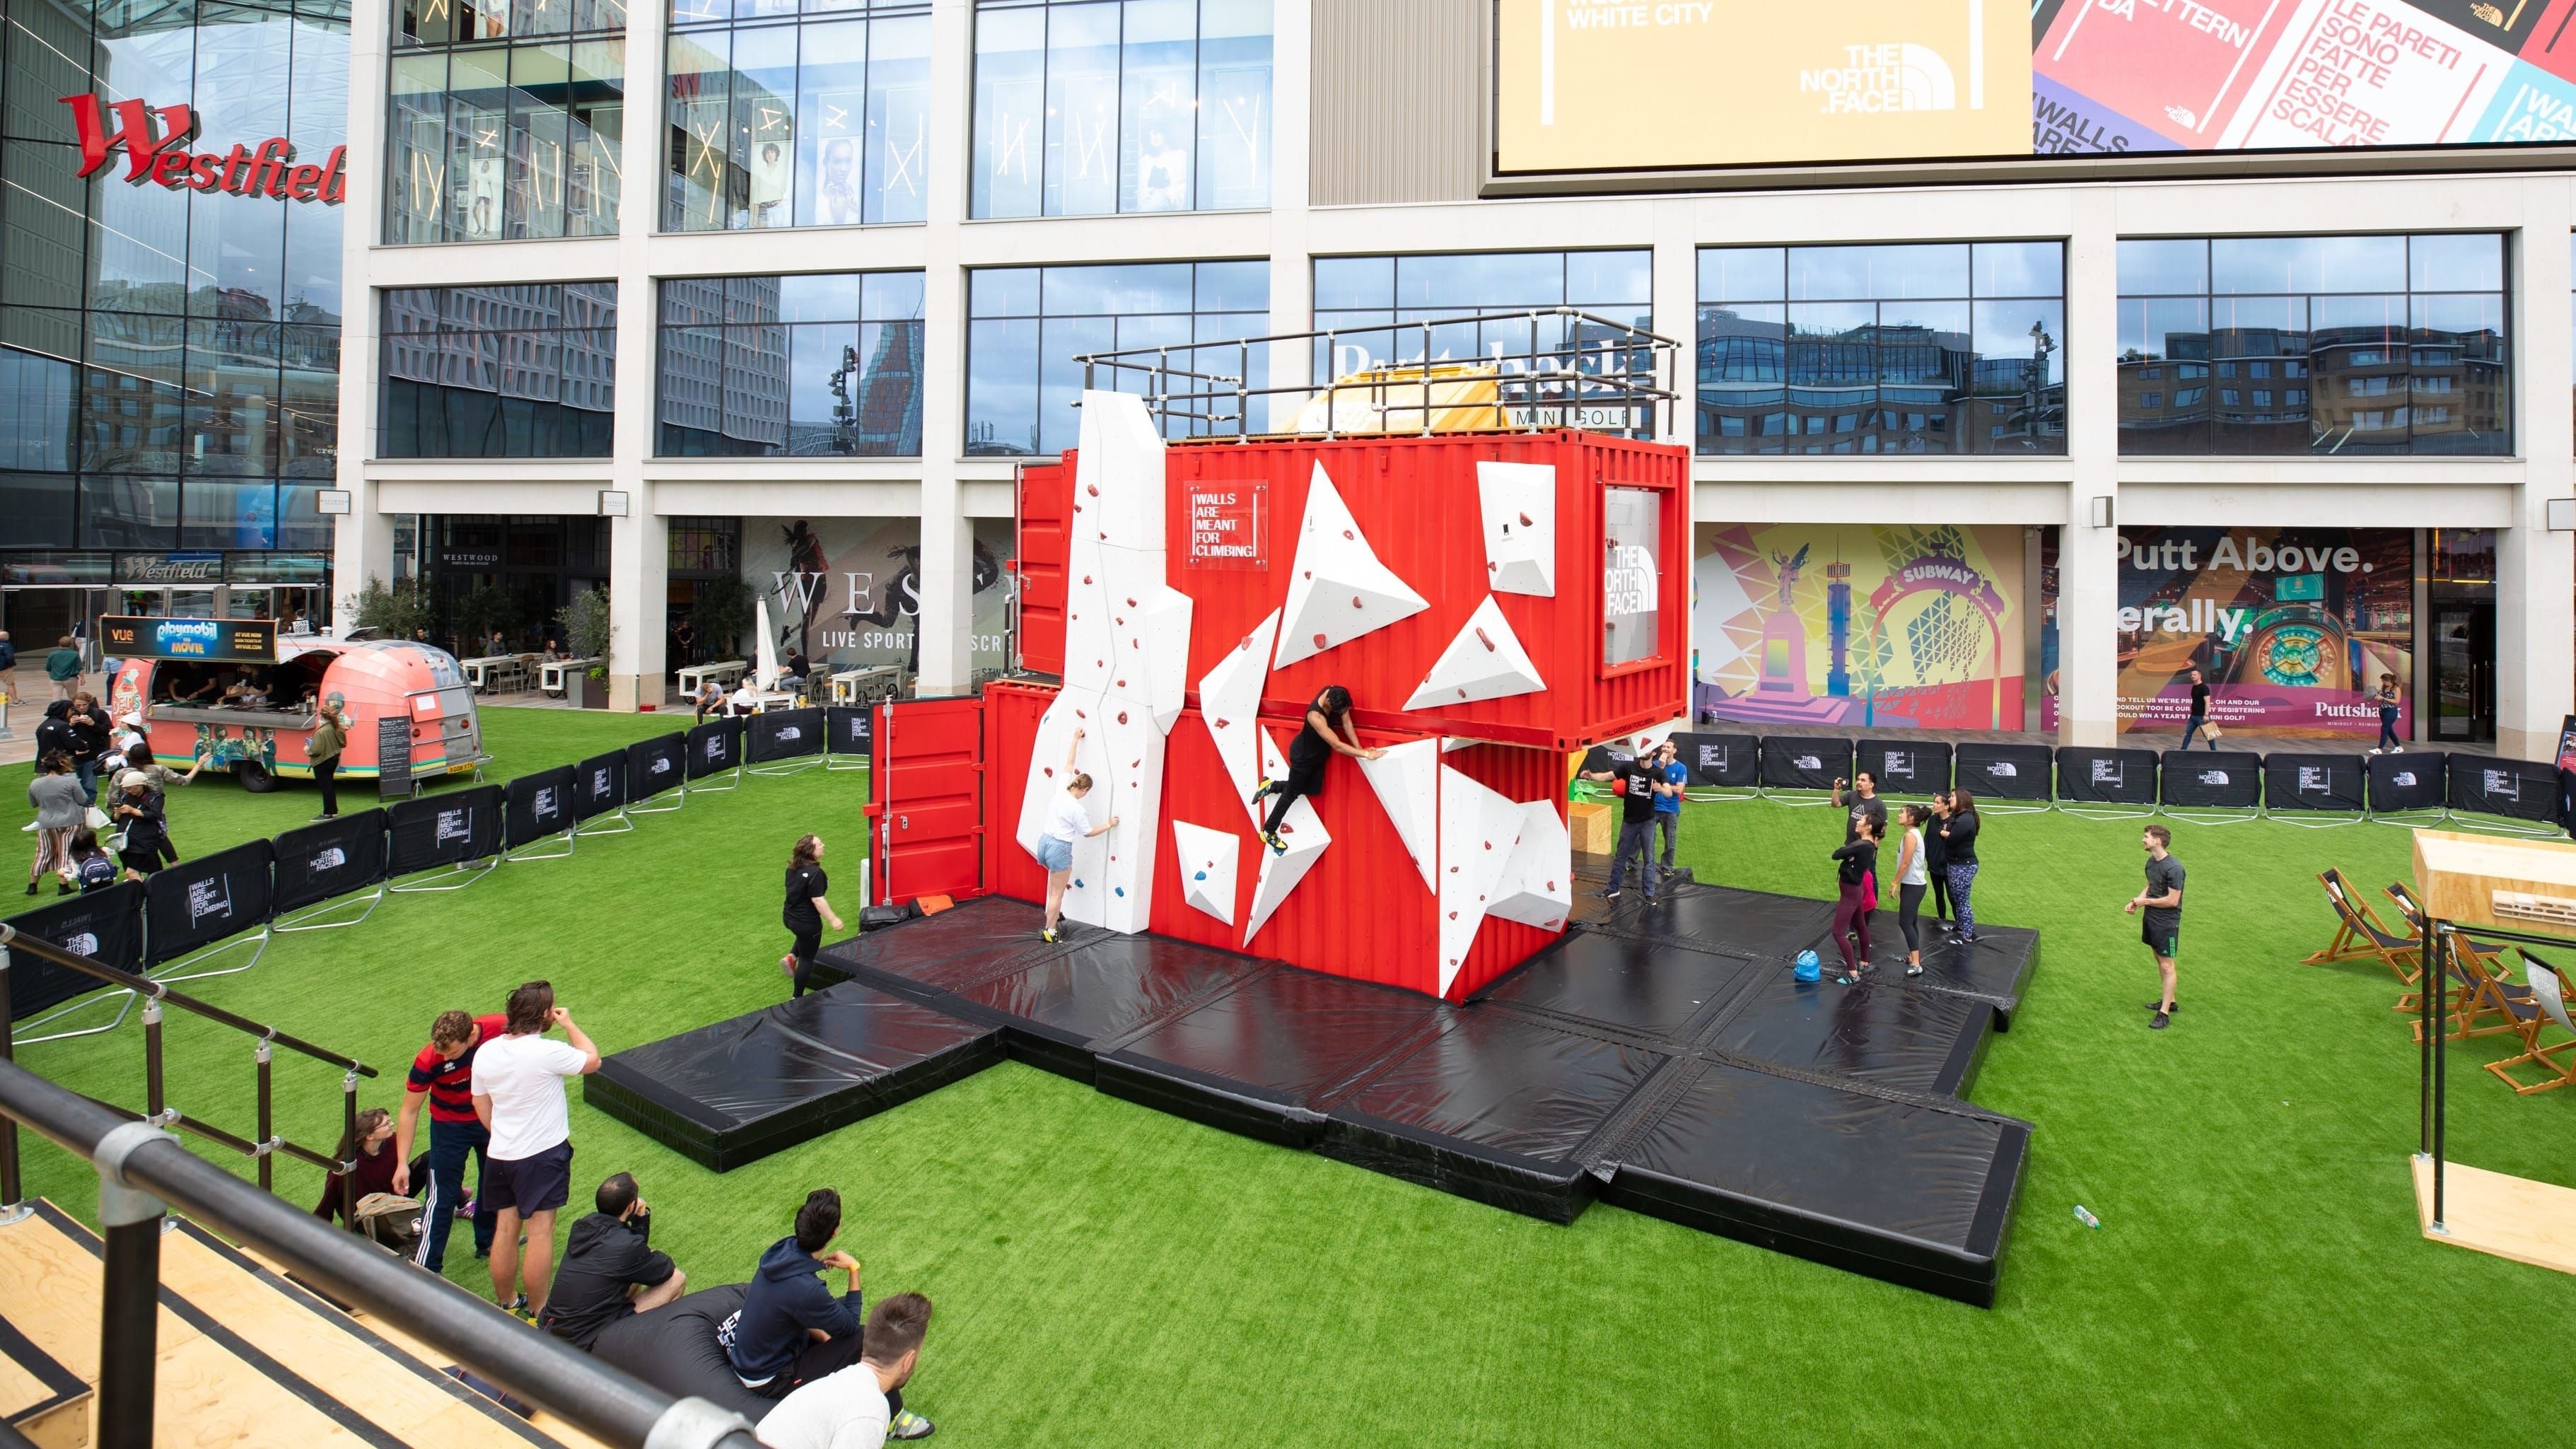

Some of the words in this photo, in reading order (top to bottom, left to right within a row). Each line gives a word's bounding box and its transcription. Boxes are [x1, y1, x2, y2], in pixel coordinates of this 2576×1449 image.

[1567, 6, 1648, 30] WHITE
[1655, 1, 1714, 25] CITY
[2321, 16, 2399, 66] SONO
[2368, 12, 2462, 70] PARETI
[1844, 43, 1900, 68] THE
[2309, 36, 2391, 89] FATTE
[1800, 66, 1900, 92] NORTH
[2297, 57, 2352, 96] PER
[2284, 77, 2390, 142] ESSERE
[2036, 96, 2130, 151] WALLS
[1517, 411, 1563, 425] MIN
[1196, 494, 1235, 504] WALLS
[1196, 506, 1219, 518] ARE
[1196, 520, 1237, 530] MEANT
[1196, 533, 1220, 543] FOR
[1196, 545, 1252, 557] CLIMBING
[1614, 546, 1638, 569] THE
[2208, 537, 2373, 573] Above.
[125, 556, 211, 579] Westfield
[1902, 564, 1974, 585] SUBWAY
[1605, 568, 1638, 592] ORTH
[1607, 590, 1638, 617] FACE
[157, 622, 217, 641] playmobil
[823, 631, 856, 648] LIVE
[172, 642, 204, 653] MOVIE
[2315, 702, 2402, 718] Puttshak
[441, 809, 462, 817] WALLS
[441, 820, 462, 828] MEANT
[440, 829, 469, 839] CLIMBING
[310, 856, 332, 867] NORTH
[320, 849, 333, 858] THE
[317, 861, 333, 871] FACE
[192, 878, 214, 890] WALLS
[192, 888, 206, 897] ARE
[193, 890, 216, 904] MEANT
[194, 901, 209, 910] FOR
[194, 900, 228, 917] CLIMBING
[66, 934, 83, 946] THE
